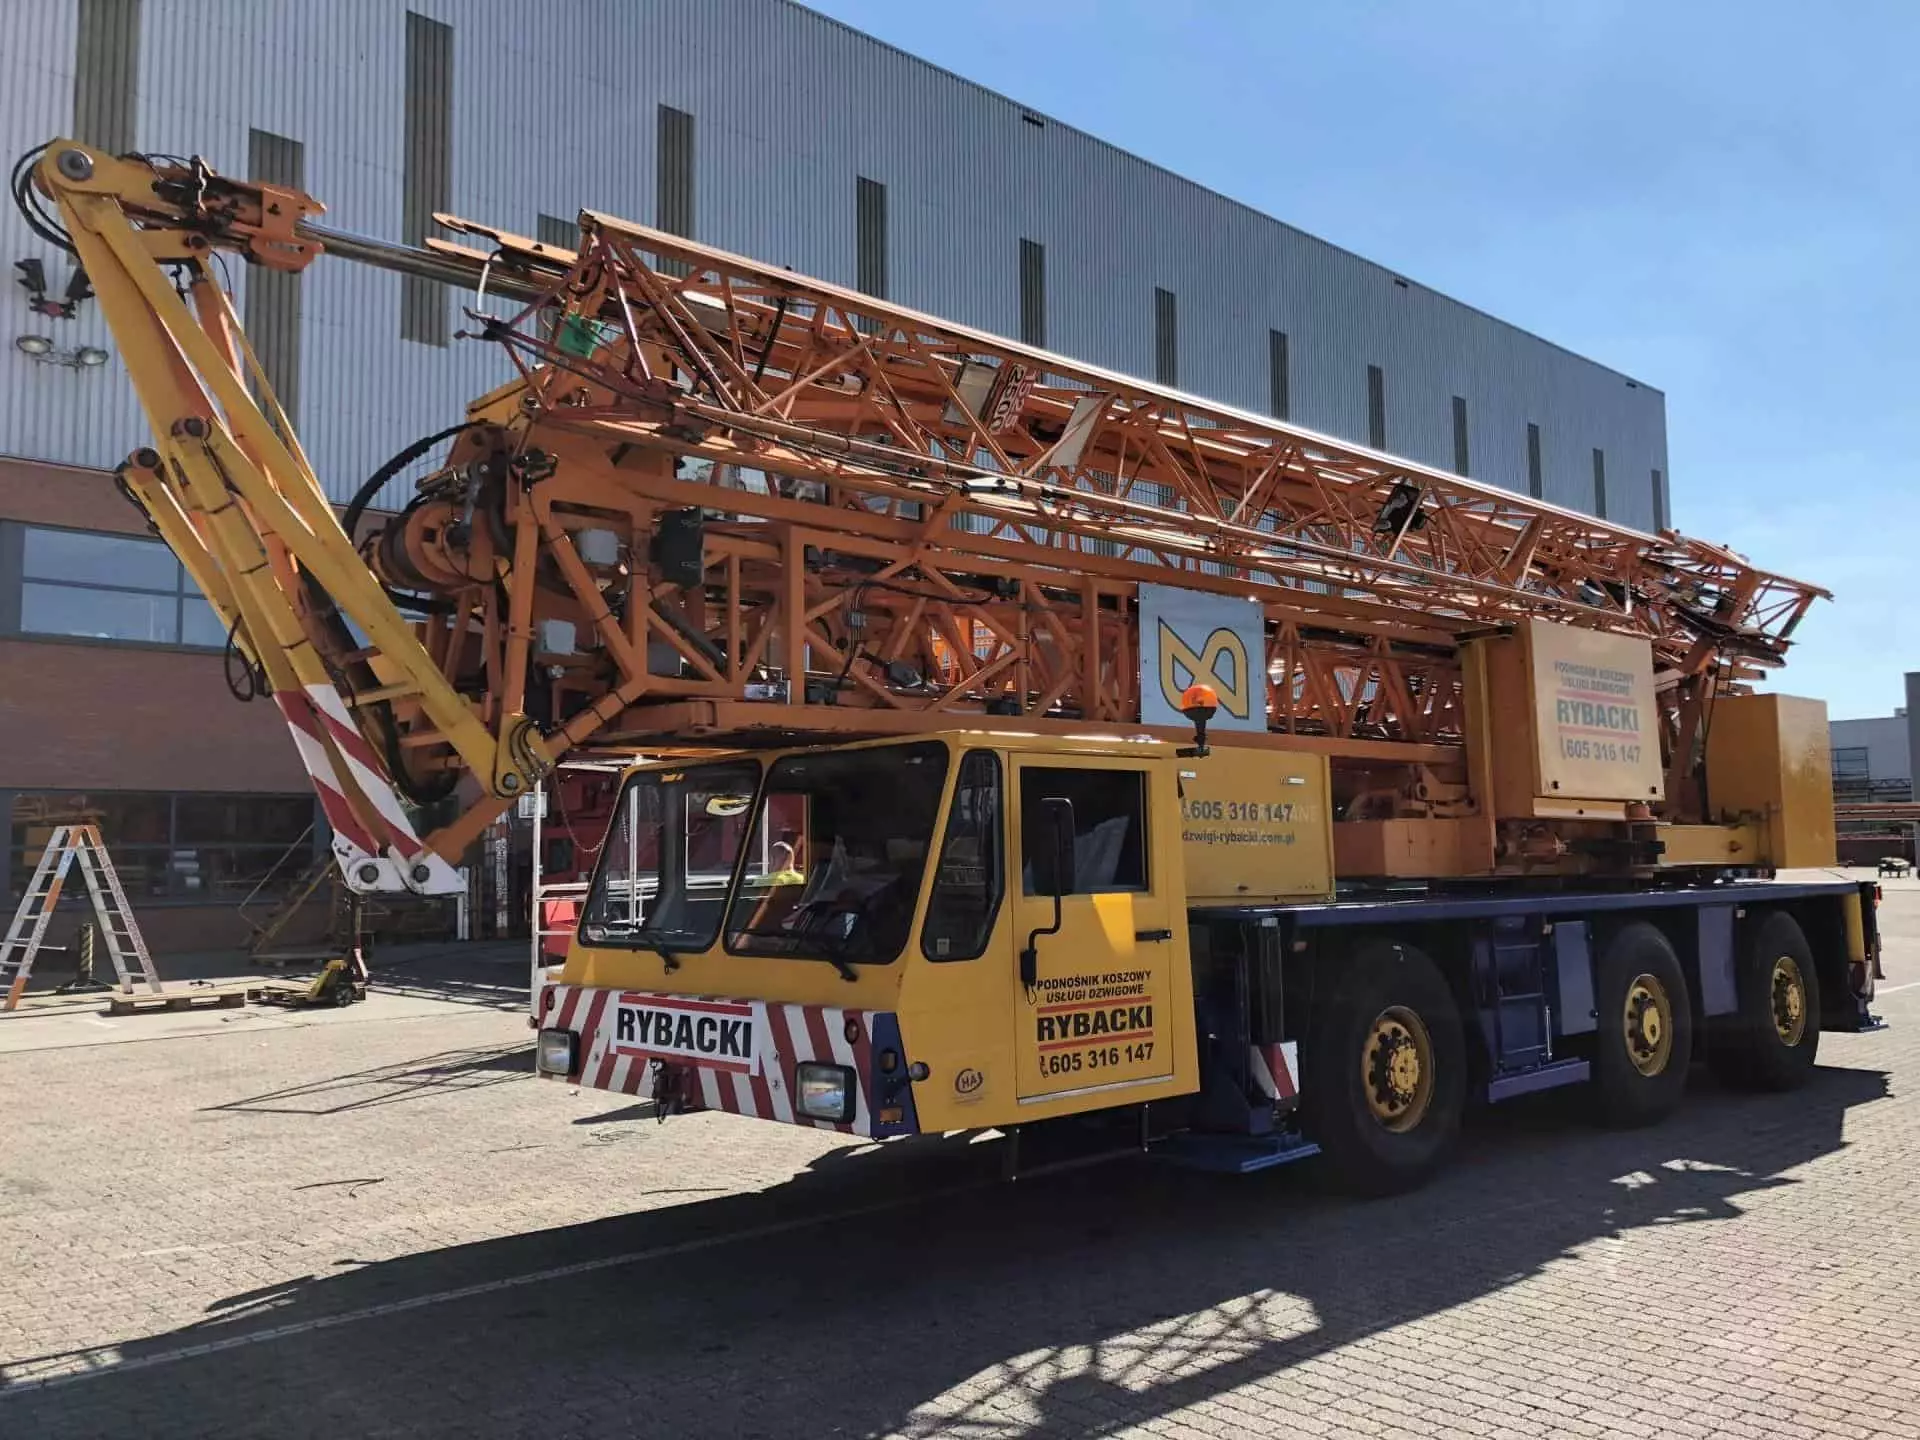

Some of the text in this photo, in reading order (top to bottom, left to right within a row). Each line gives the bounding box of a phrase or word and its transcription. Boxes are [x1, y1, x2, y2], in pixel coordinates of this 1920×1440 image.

[1557, 699, 1639, 732] RYBACKI
[1566, 739, 1641, 764] 605 316 147
[1191, 801, 1222, 820] 605
[1228, 802, 1258, 821] 316
[1264, 804, 1293, 822] 147
[1037, 970, 1151, 990] PODNOŚNIK KOSZOWY
[1046, 989, 1086, 1003] USŁUGI
[616, 1007, 752, 1058] RYBACKI
[1037, 1005, 1153, 1041] RYBACKI
[1049, 1043, 1154, 1074] 605 316 147
